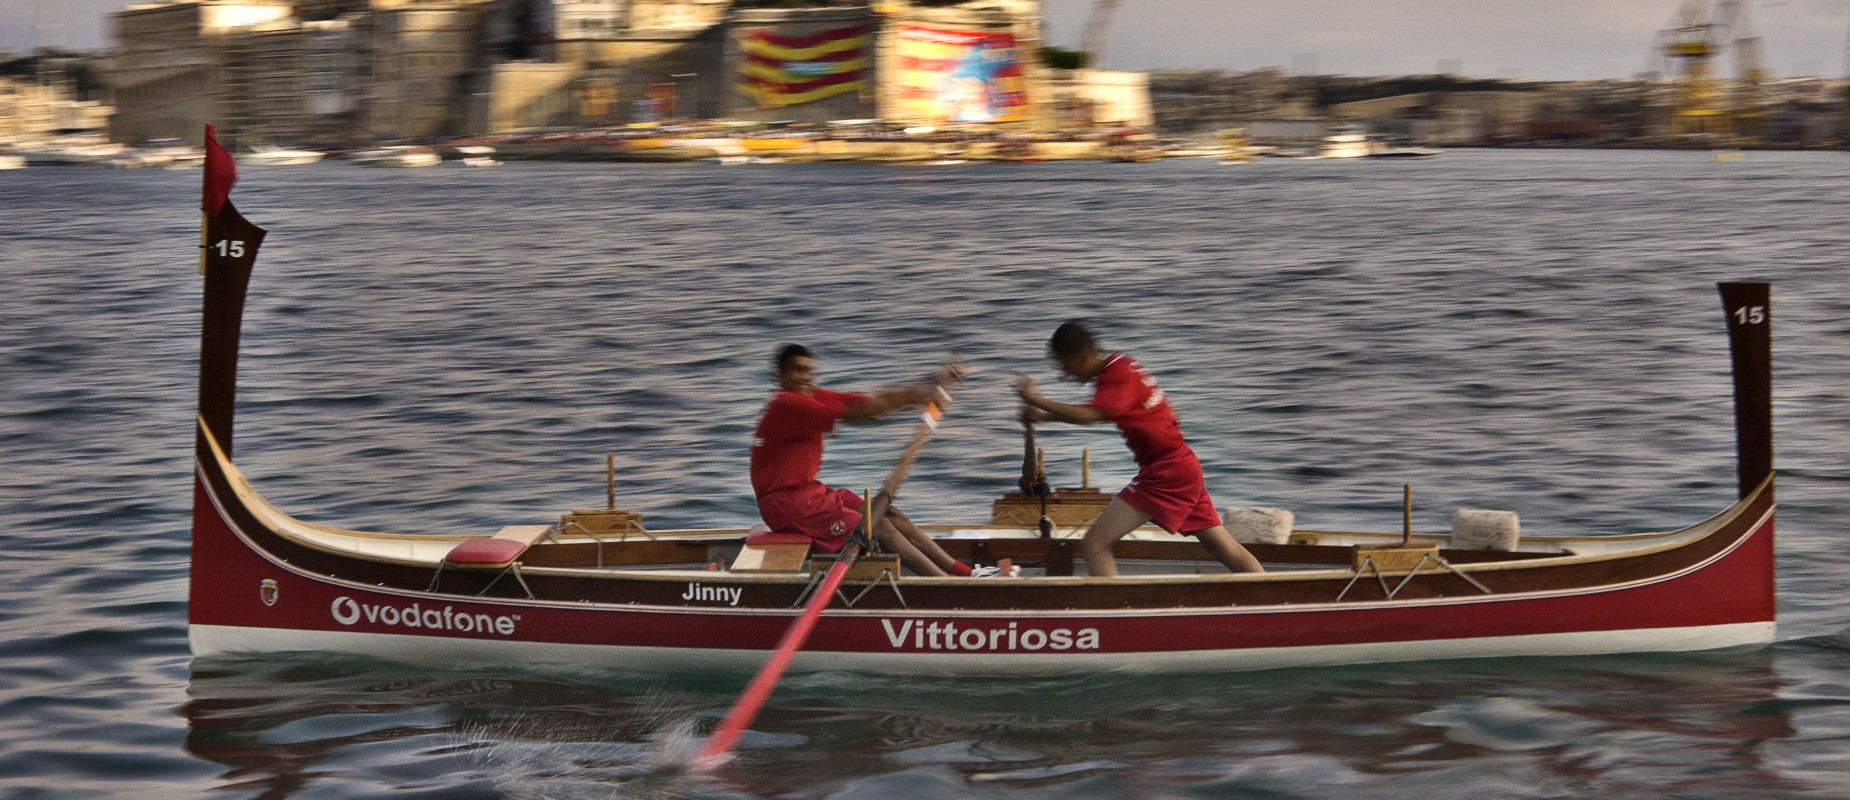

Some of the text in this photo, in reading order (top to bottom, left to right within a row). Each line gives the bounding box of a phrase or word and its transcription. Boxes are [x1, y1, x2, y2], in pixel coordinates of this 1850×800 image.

[215, 240, 245, 258] 15
[1734, 306, 1764, 325] 15
[682, 582, 742, 606] Jinny
[881, 618, 1100, 650] Vittoriosa
